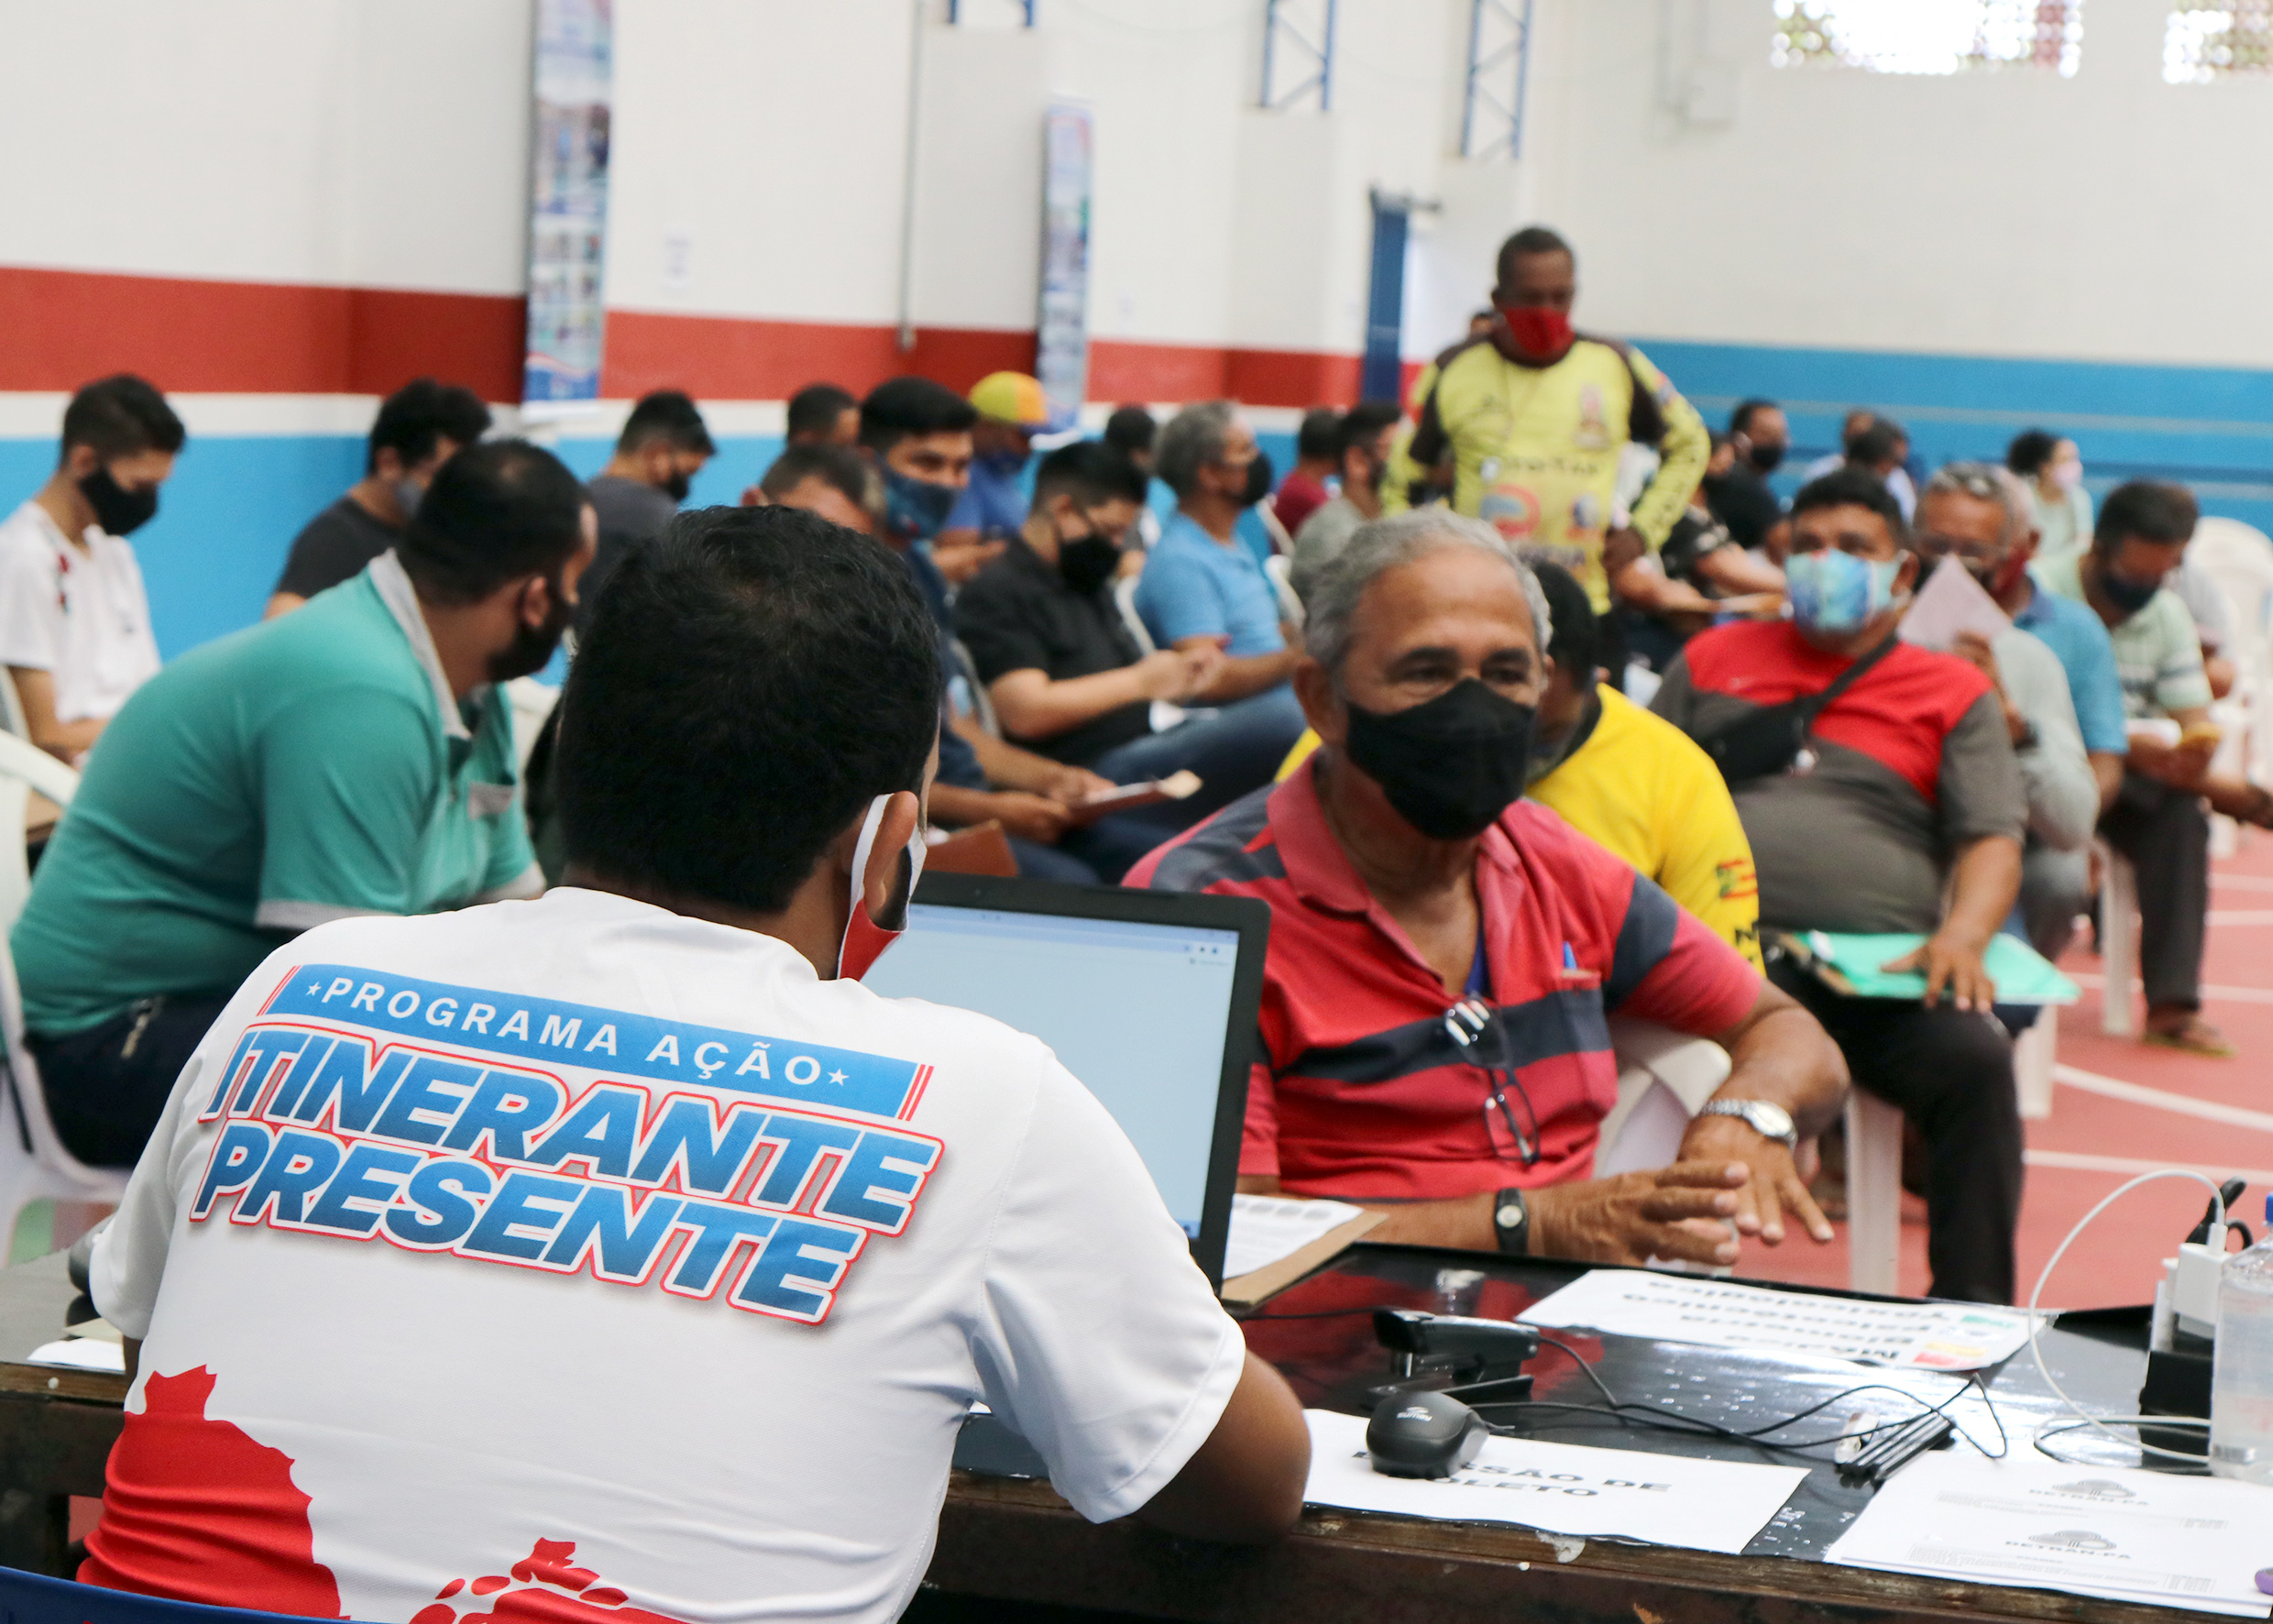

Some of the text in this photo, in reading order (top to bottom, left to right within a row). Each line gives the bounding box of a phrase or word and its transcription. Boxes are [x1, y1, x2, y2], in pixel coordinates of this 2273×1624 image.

[321, 976, 822, 1086] PROGRAMA AÇÃO
[203, 1023, 939, 1233] ITINERANTE
[192, 1120, 863, 1318] PRESENTE
[1425, 1476, 1599, 1497] OLETO
[1603, 1478, 1672, 1492] DE
